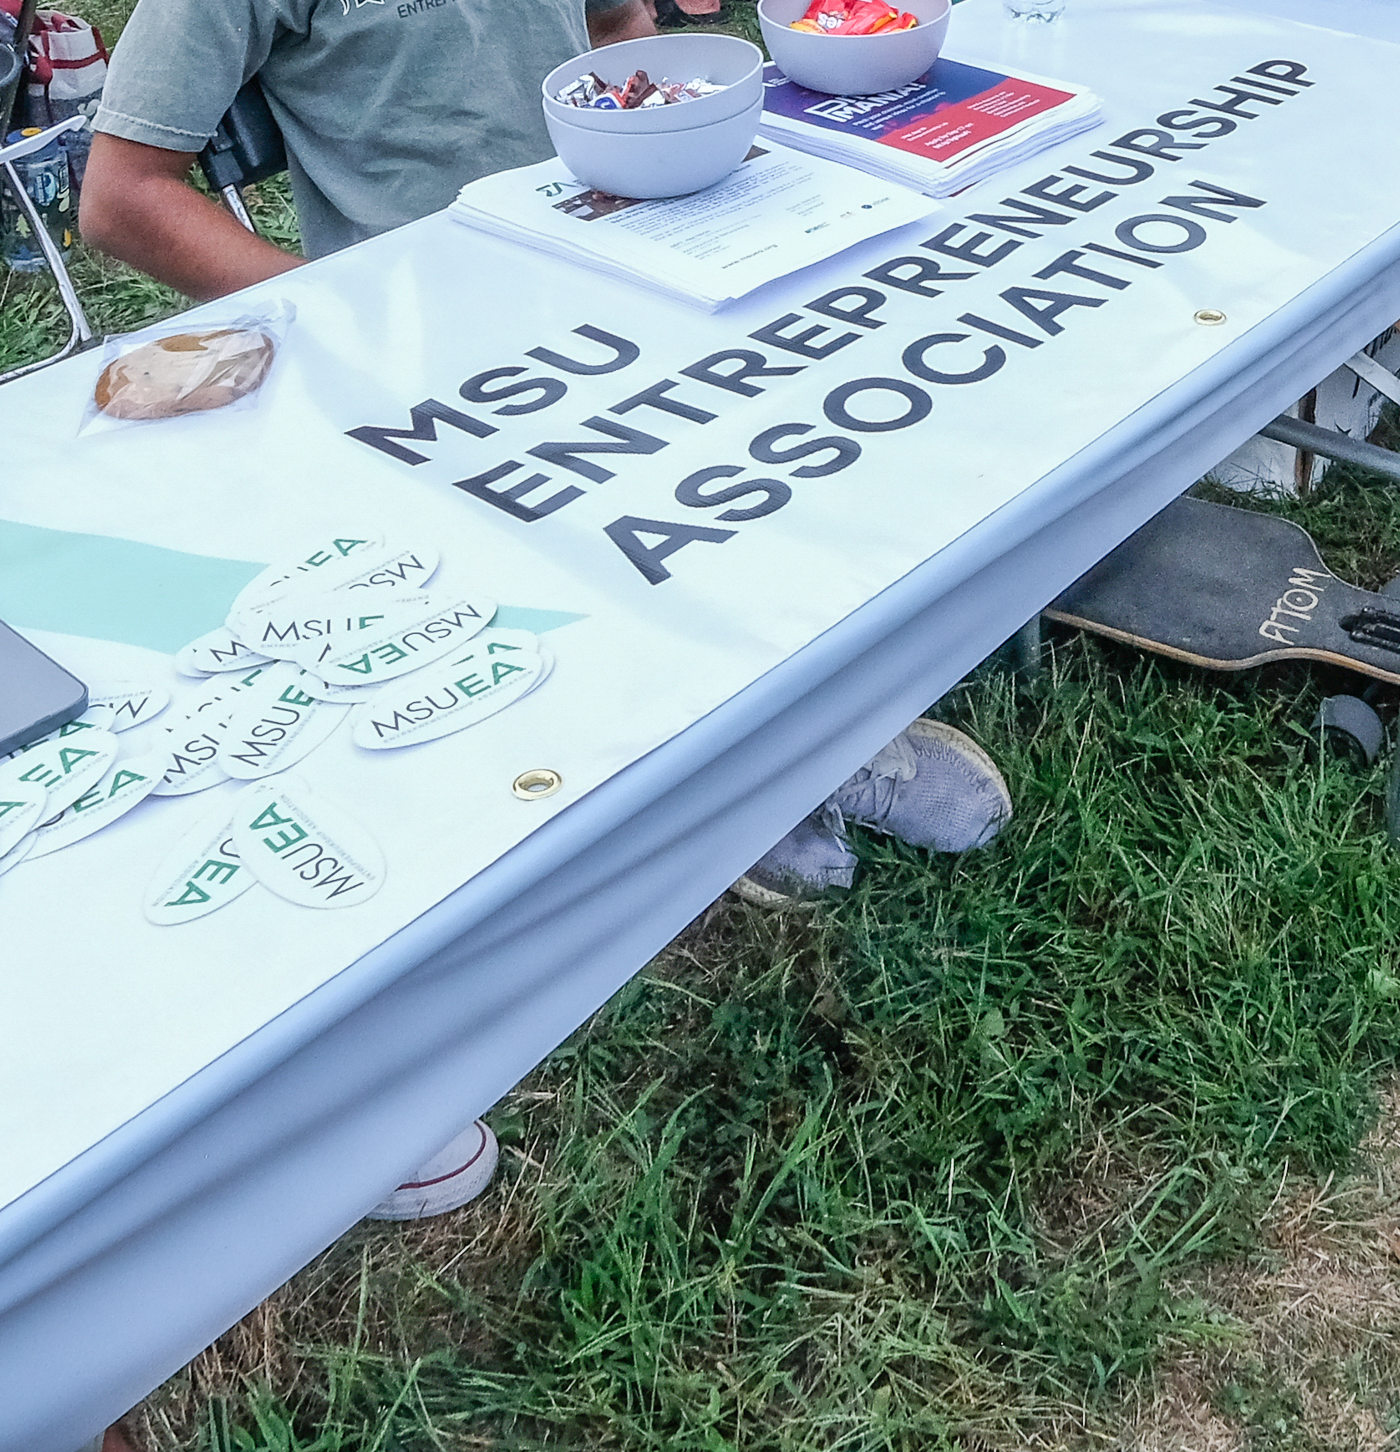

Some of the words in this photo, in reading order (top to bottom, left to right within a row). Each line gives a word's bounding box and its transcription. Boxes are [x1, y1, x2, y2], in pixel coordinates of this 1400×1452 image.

[453, 56, 1316, 522] ENTREPRENEURSHIP
[345, 323, 641, 465] MSU
[602, 178, 1268, 586] ASSOCIATION
[337, 604, 483, 674] MSUEA
[1258, 567, 1332, 646] ATOM
[371, 661, 527, 738] MSUEA
[249, 801, 365, 901] MSUEA
